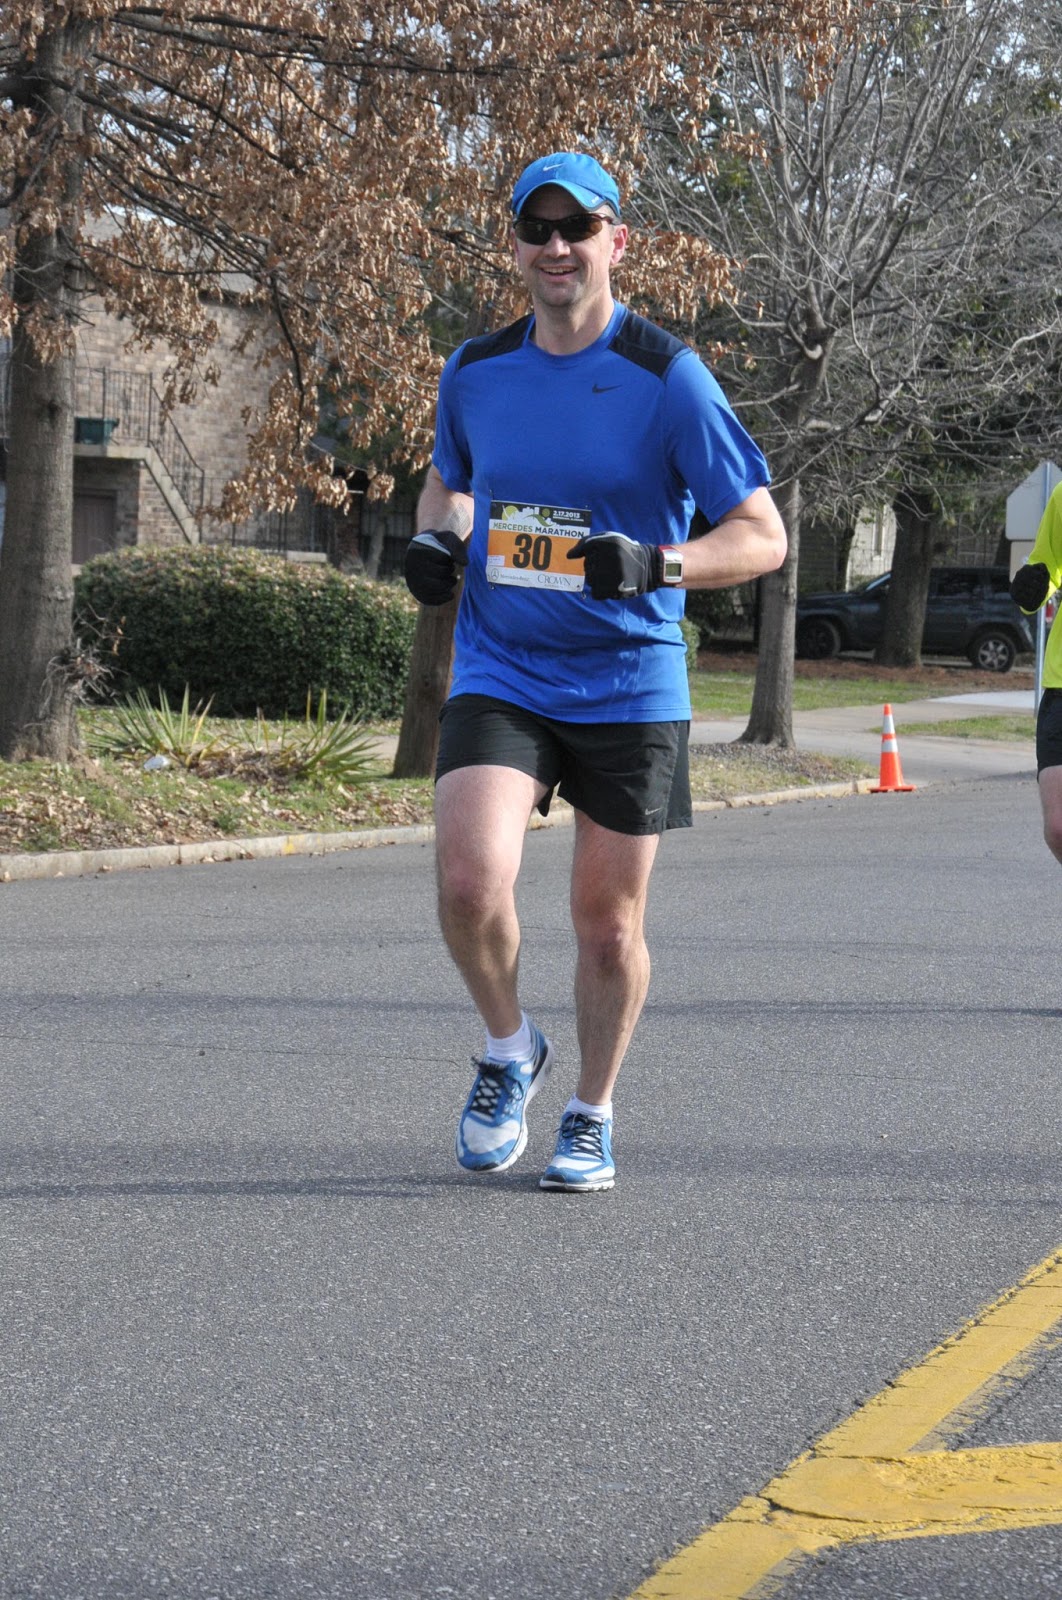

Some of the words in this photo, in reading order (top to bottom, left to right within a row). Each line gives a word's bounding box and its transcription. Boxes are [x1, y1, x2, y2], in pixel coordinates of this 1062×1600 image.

[553, 510, 581, 519] 2.17.2013
[493, 522, 533, 533] MERCEDES
[535, 526, 585, 539] MARATHON
[512, 533, 553, 571] 30
[537, 573, 572, 586] CROWN
